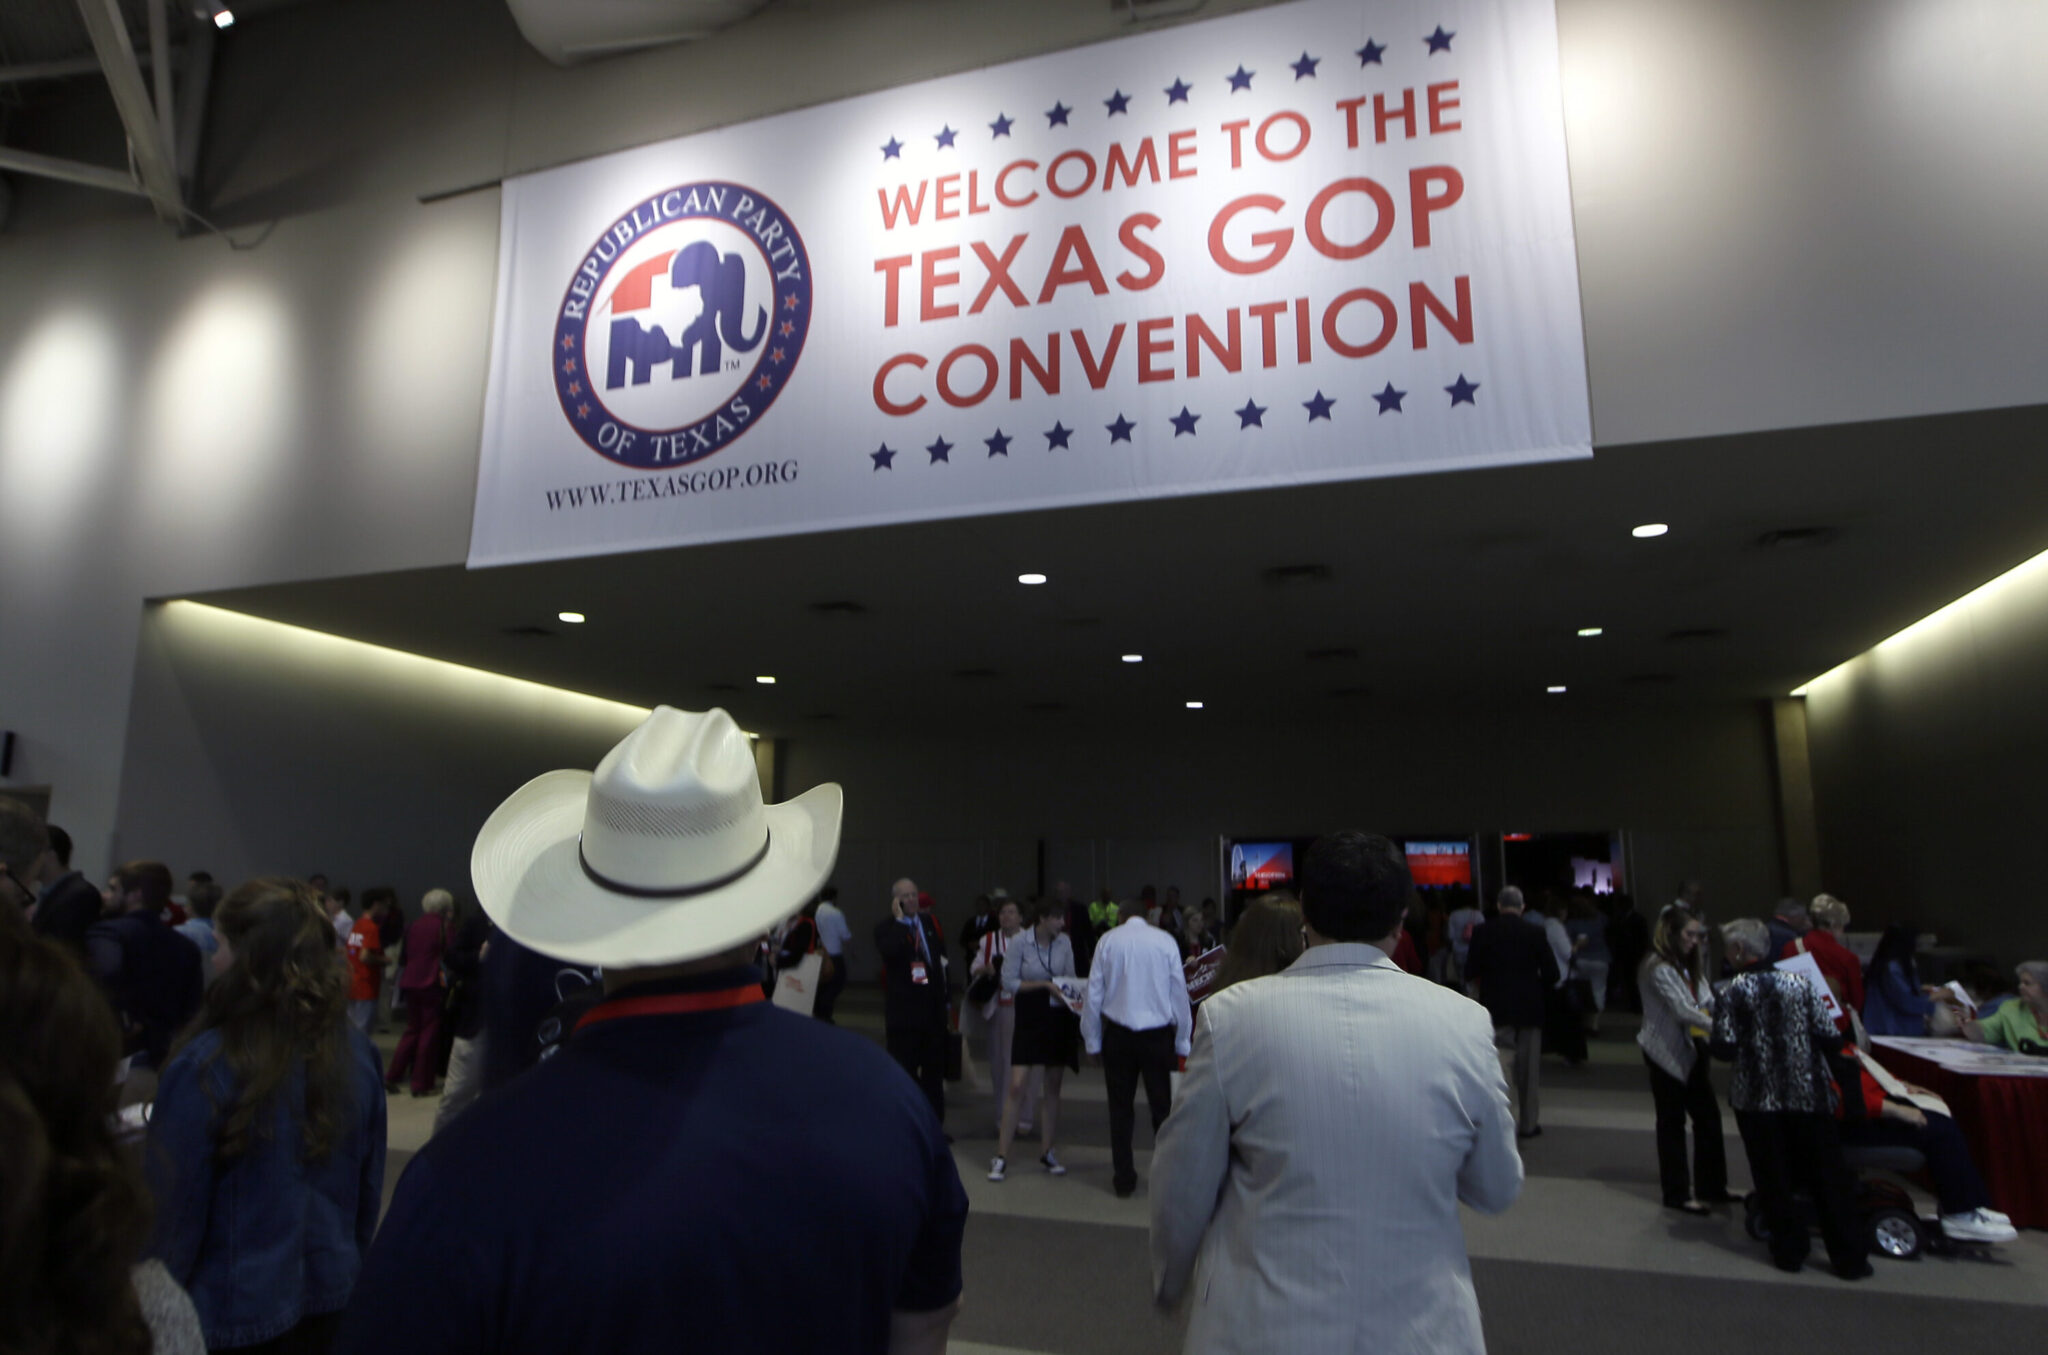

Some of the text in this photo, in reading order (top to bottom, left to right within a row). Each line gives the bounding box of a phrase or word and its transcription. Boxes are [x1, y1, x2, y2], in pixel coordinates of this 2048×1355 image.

[877, 79, 1463, 231] WELCOME TO THE
[563, 185, 802, 321] REPUBLICAN PARTY
[873, 164, 1466, 328] TEXAS GOP
[872, 275, 1475, 417] CONVENTION
[546, 460, 799, 512] WWW.TEXASGOP.ORG
[597, 396, 750, 462] OF TEXAS
